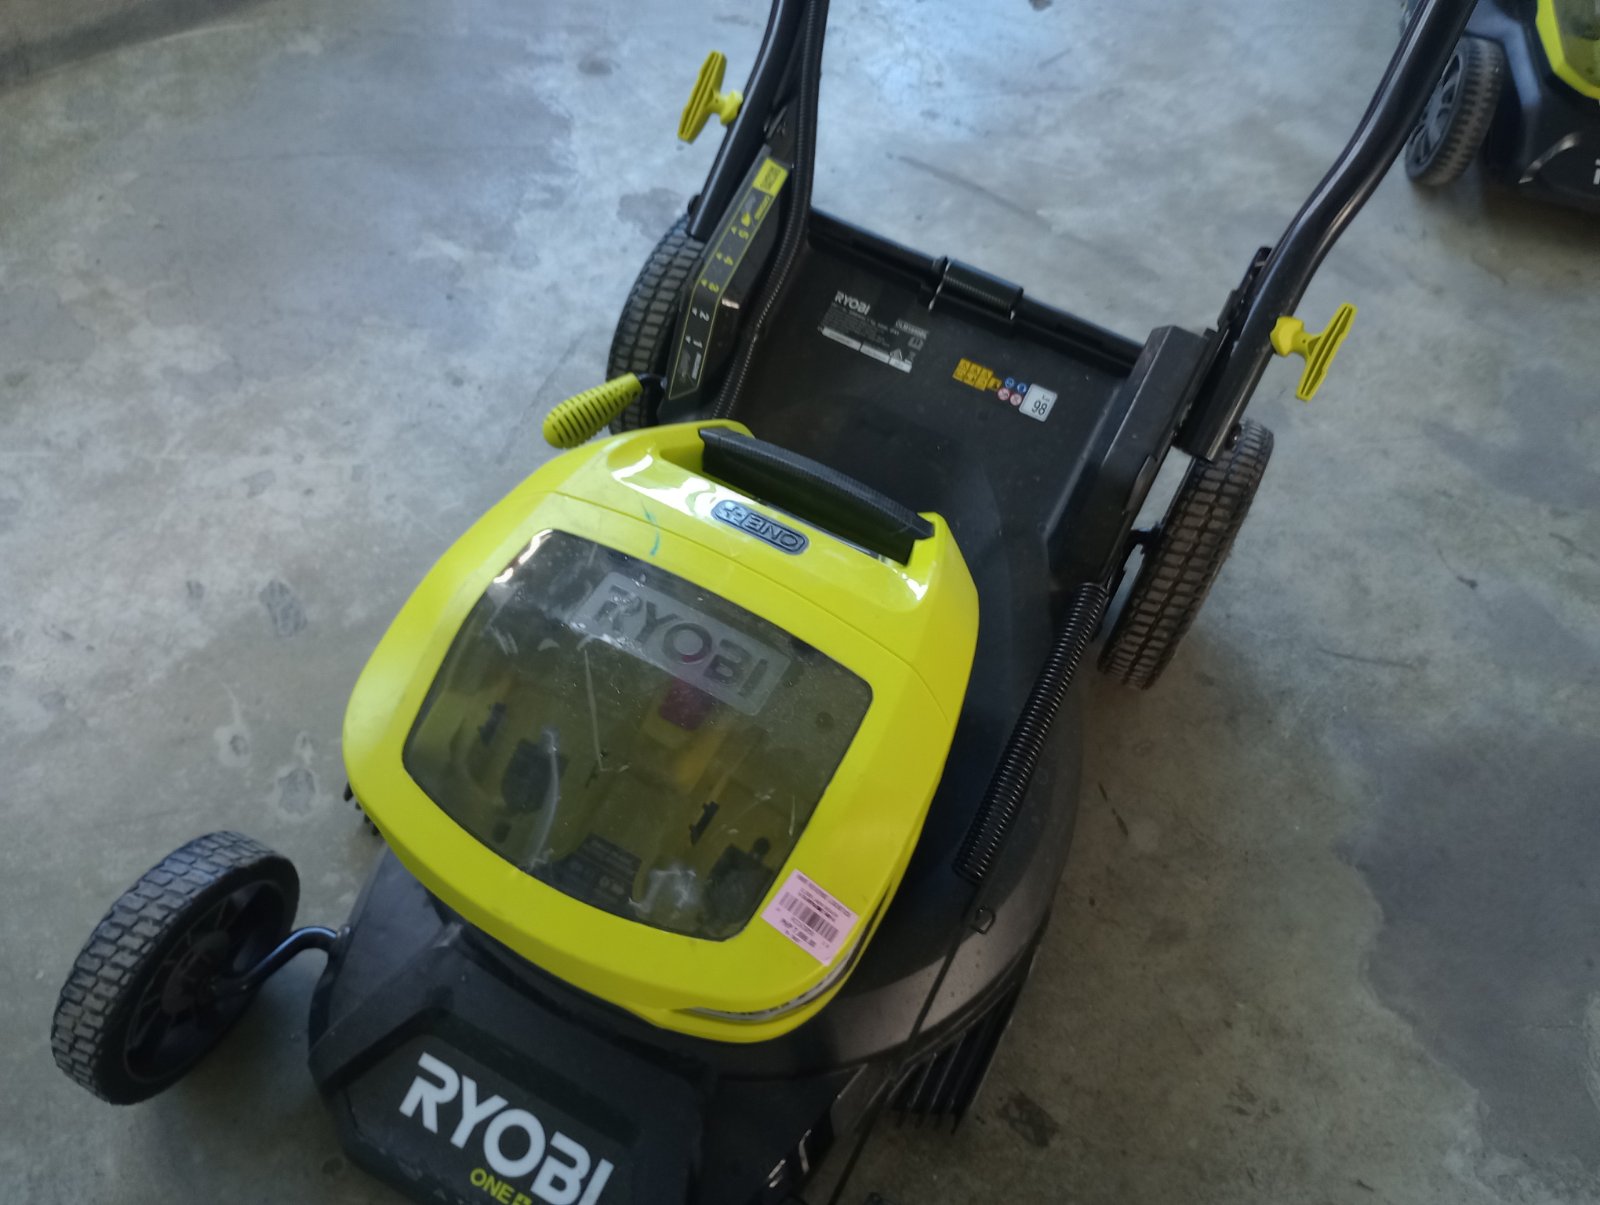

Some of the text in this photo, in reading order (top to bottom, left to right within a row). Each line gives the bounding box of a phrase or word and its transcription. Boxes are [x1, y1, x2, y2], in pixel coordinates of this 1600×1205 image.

[834, 290, 871, 316] RYOBI
[1031, 399, 1048, 416] 98
[596, 584, 769, 698] RYOBI
[398, 1051, 615, 1205] RYOBI
